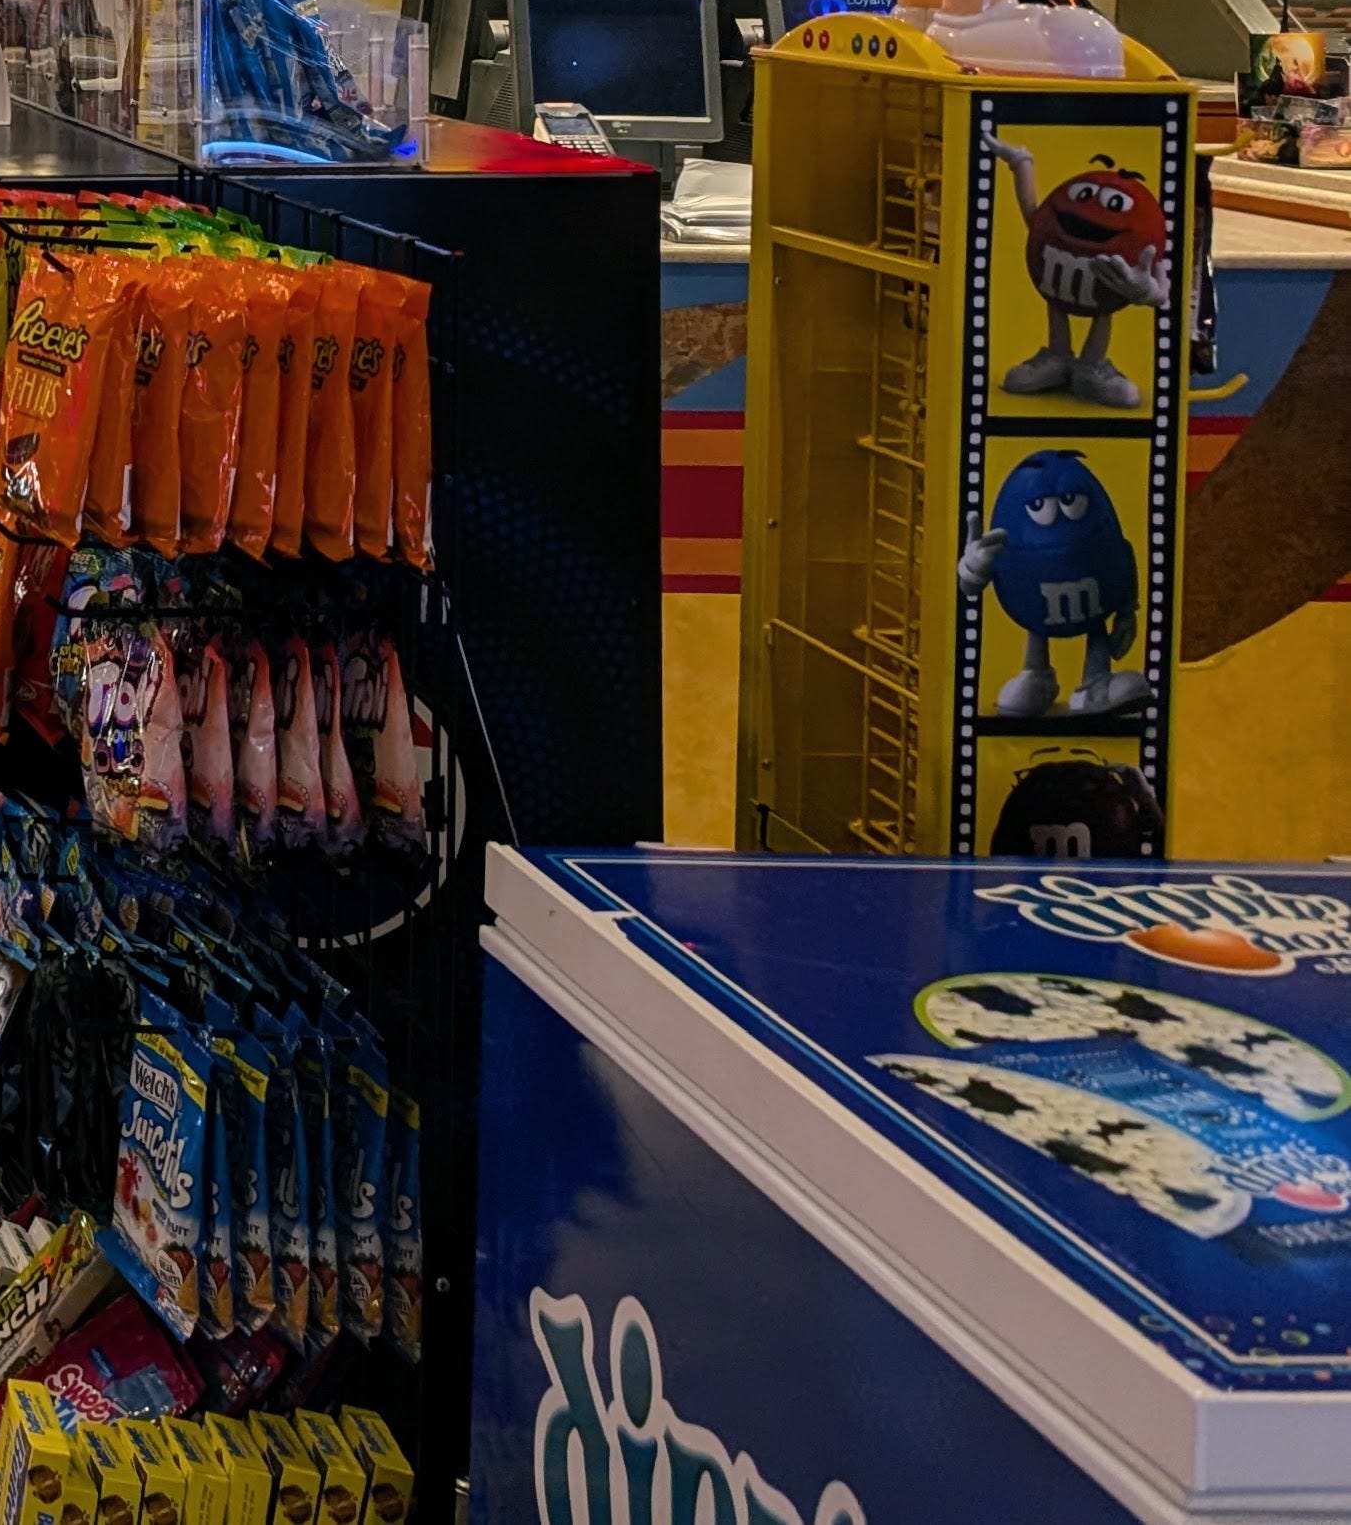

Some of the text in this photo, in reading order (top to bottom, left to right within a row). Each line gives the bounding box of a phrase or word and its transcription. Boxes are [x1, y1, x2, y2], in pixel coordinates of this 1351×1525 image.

[9, 299, 90, 362] Reese's
[1040, 577, 1100, 625] m
[133, 1060, 177, 1108] Welch's
